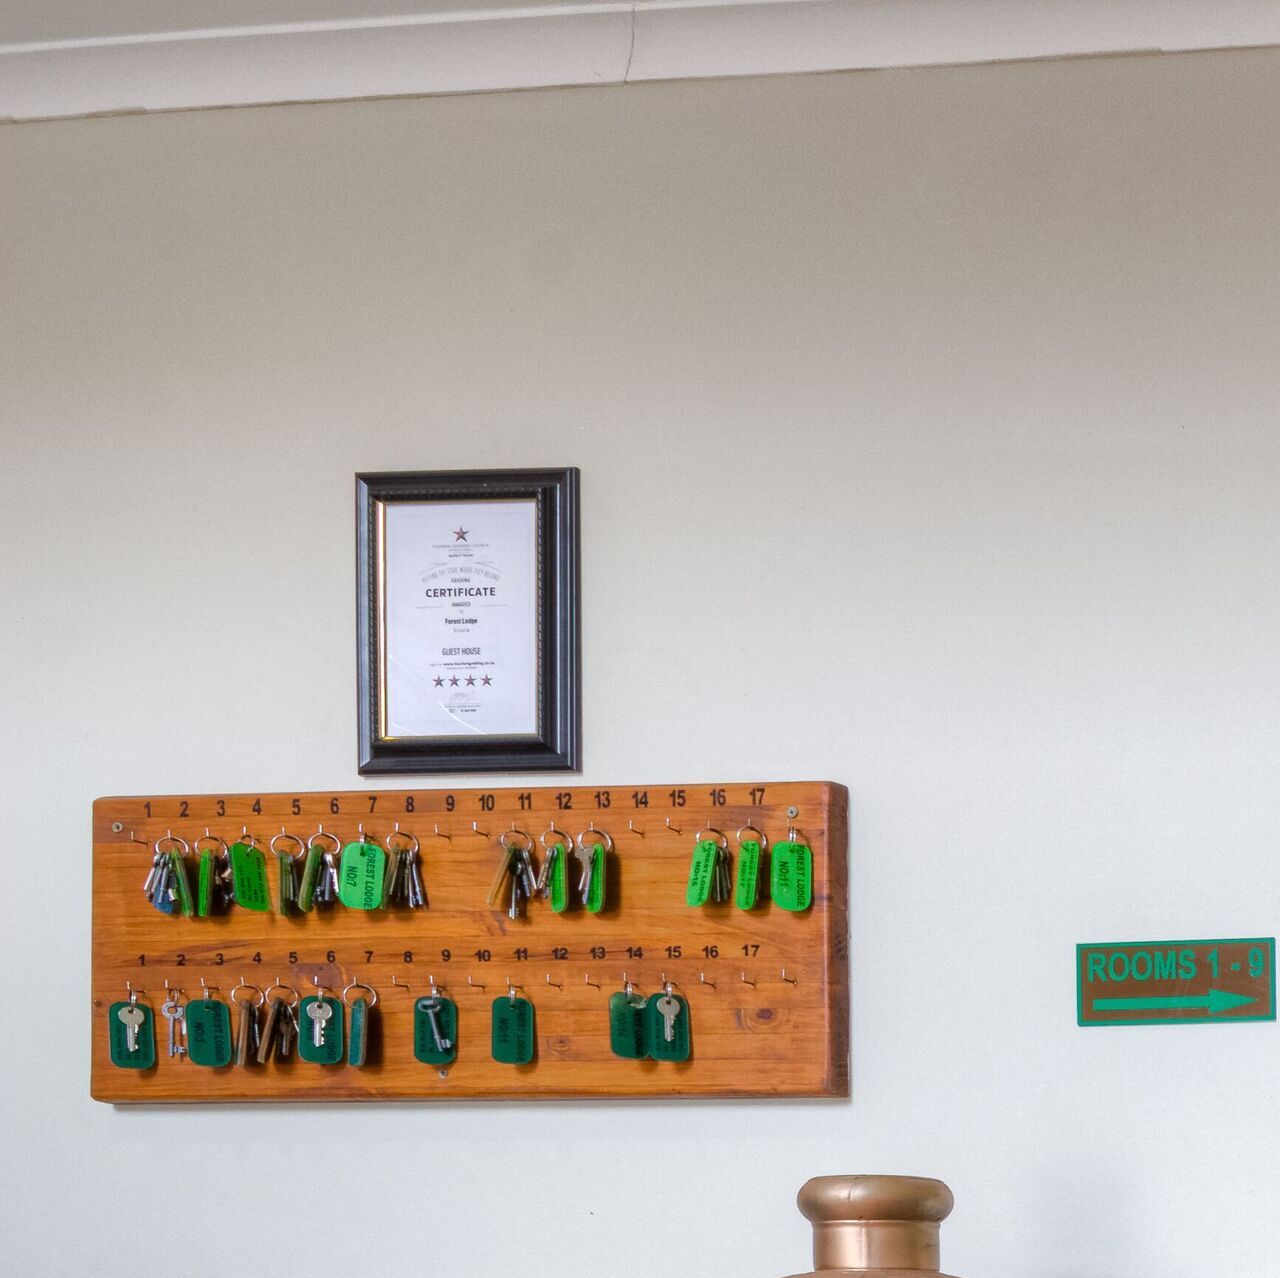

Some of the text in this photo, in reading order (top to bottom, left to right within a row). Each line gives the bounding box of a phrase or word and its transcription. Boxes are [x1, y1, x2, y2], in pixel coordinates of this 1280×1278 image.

[425, 587, 496, 598] CERTIFICATE
[442, 647, 481, 656] GUEST HOUSE
[143, 788, 766, 819] 1 2 3 4 5 6 7 8 9 10 11 12 13 14 15 16 17
[703, 842, 714, 873] FOREST
[346, 865, 358, 888] NO:7
[363, 845, 377, 909] FOREST LODGE
[796, 844, 806, 908] FOREST LODGE
[138, 944, 760, 967] 1 2 3 4 5 6 7 8 9 10 11 12 13 14 15 16 17
[1087, 949, 1197, 983] ROOMS
[1206, 947, 1220, 979] 1
[1248, 946, 1264, 978] 9
[214, 1034, 225, 1063] LODGE
